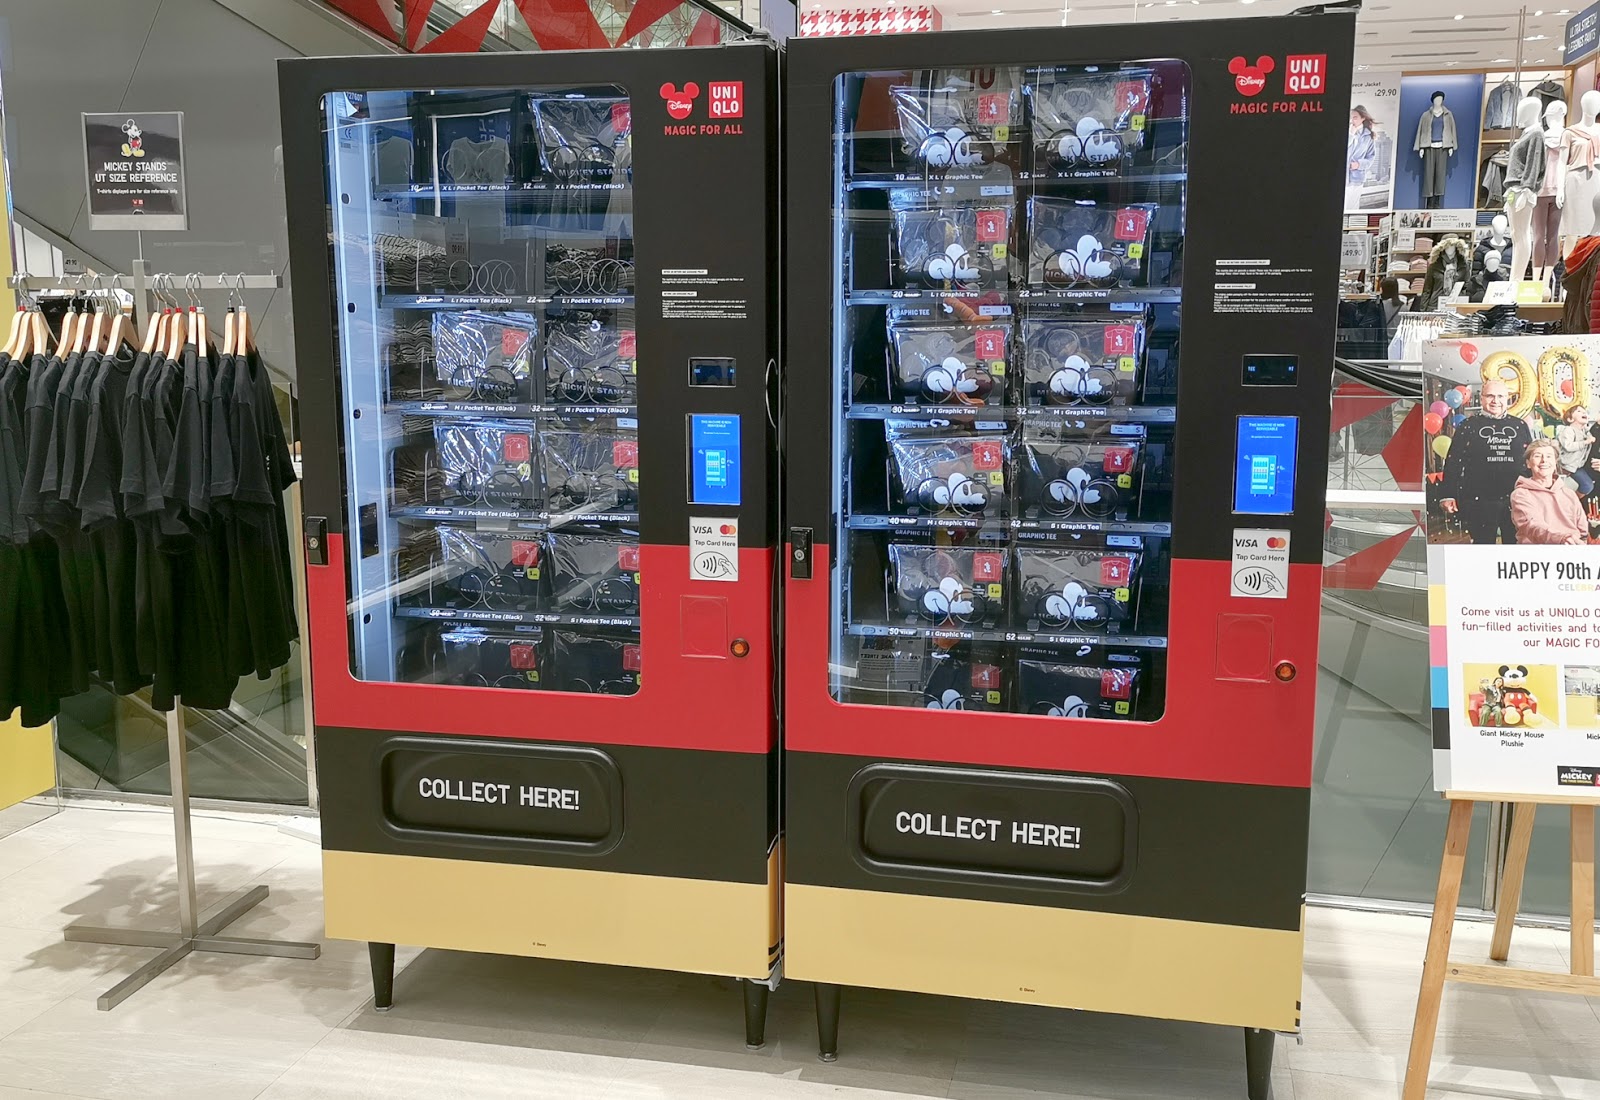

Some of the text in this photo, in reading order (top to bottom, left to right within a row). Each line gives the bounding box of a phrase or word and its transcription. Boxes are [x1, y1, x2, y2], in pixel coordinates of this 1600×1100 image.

[1290, 59, 1319, 74] UNI
[1236, 76, 1265, 87] Disney
[1289, 75, 1320, 92] QLO
[712, 86, 737, 99] UNI
[668, 100, 692, 111] Disney
[712, 100, 739, 116] QLO
[1230, 101, 1323, 114] MAGIC FOR ALL
[664, 124, 743, 136] MAGIC FOR ALL
[104, 162, 167, 172] MICKEY STANDS
[95, 173, 178, 182] UT SIZE REFERENCE
[692, 526, 713, 534] VISA
[1234, 539, 1258, 547] VISA
[1498, 562, 1591, 580] HAPPY 90th
[1461, 607, 1490, 616] Come
[1495, 607, 1514, 616] visit
[1535, 608, 1544, 617] at
[1549, 608, 1590, 618] UNIQLO
[1462, 621, 1511, 632] fun-filled
[1517, 623, 1562, 633] activities
[1568, 624, 1587, 633] and
[1546, 638, 1581, 648] MAGIC
[419, 777, 580, 810] COLLECT HERE!
[896, 811, 1081, 849] COLLECT HERE!
